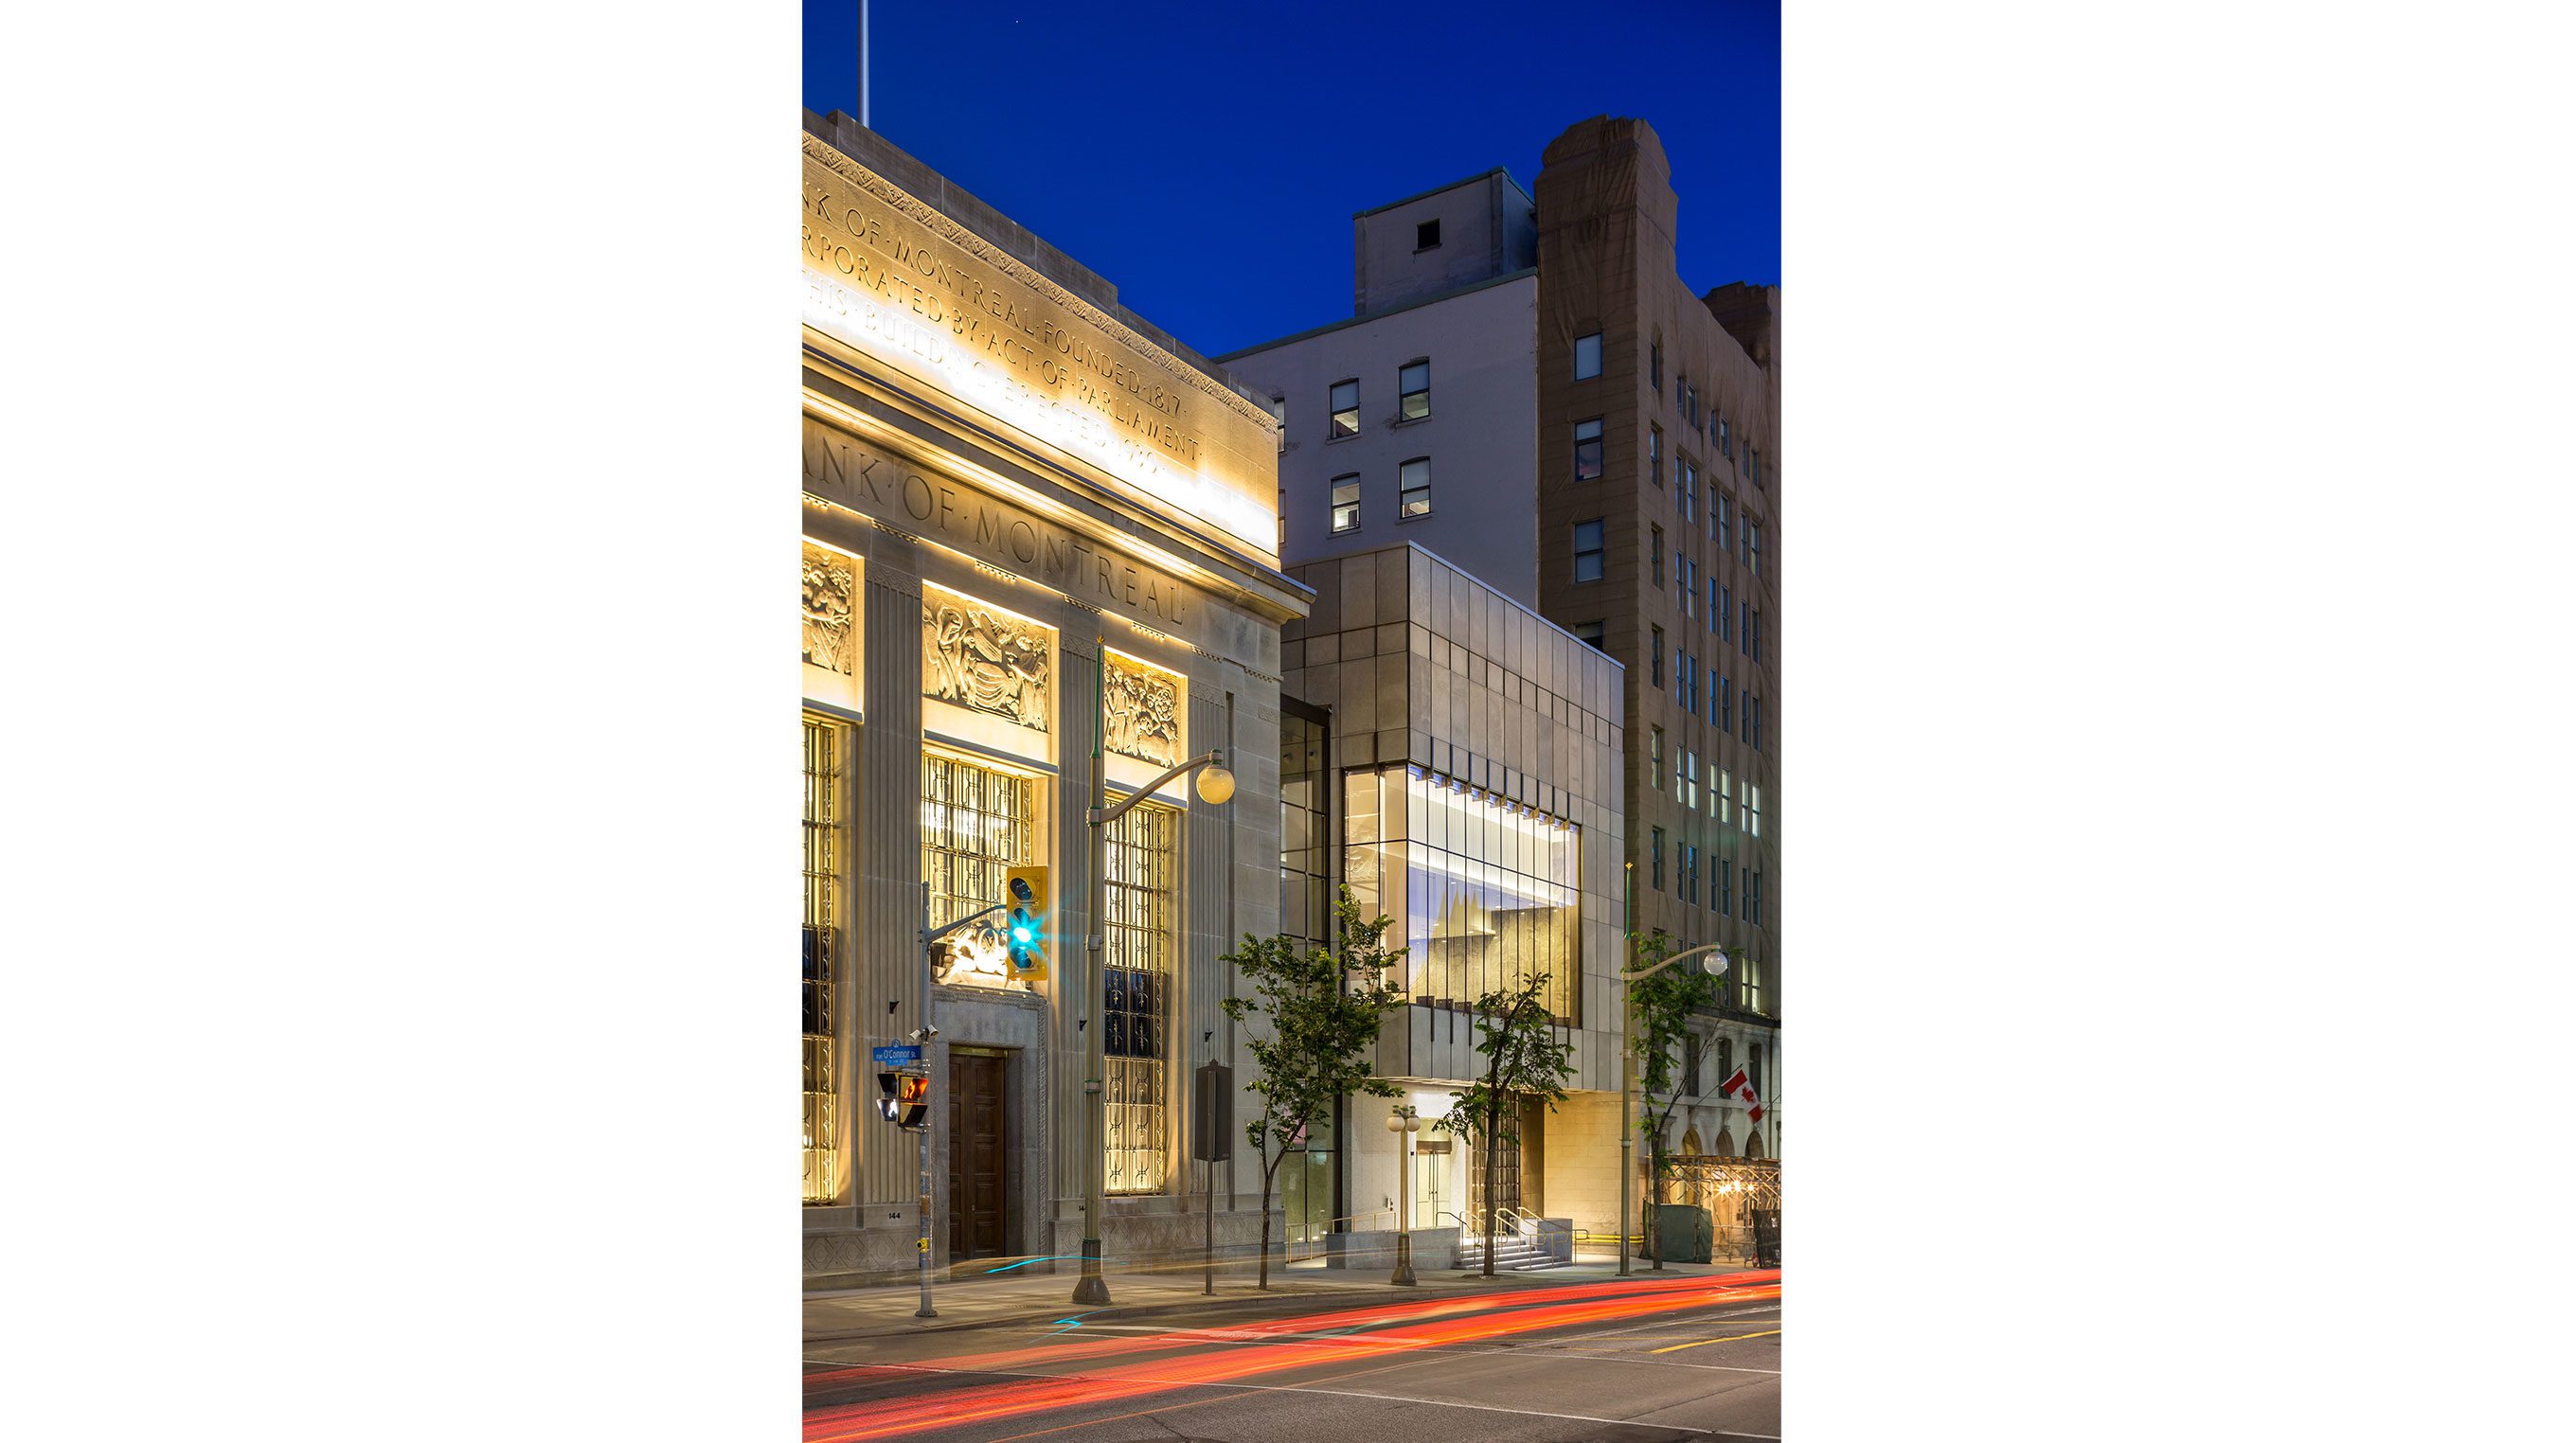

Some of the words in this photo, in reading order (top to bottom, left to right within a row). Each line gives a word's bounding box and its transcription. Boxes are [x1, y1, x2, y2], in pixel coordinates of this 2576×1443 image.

[846, 208, 881, 244] OF
[895, 236, 1034, 335] MONTREAL
[1045, 320, 1140, 394] FOUNDED
[1148, 383, 1181, 418] 1817
[953, 308, 978, 342] BY
[988, 330, 1033, 371] ACT
[1042, 359, 1068, 389] OF
[1078, 377, 1199, 460] PARLIAMENT
[903, 475, 955, 531] OF
[975, 505, 1183, 626] MONTREAL
[883, 1049, 910, 1060] O'Connor
